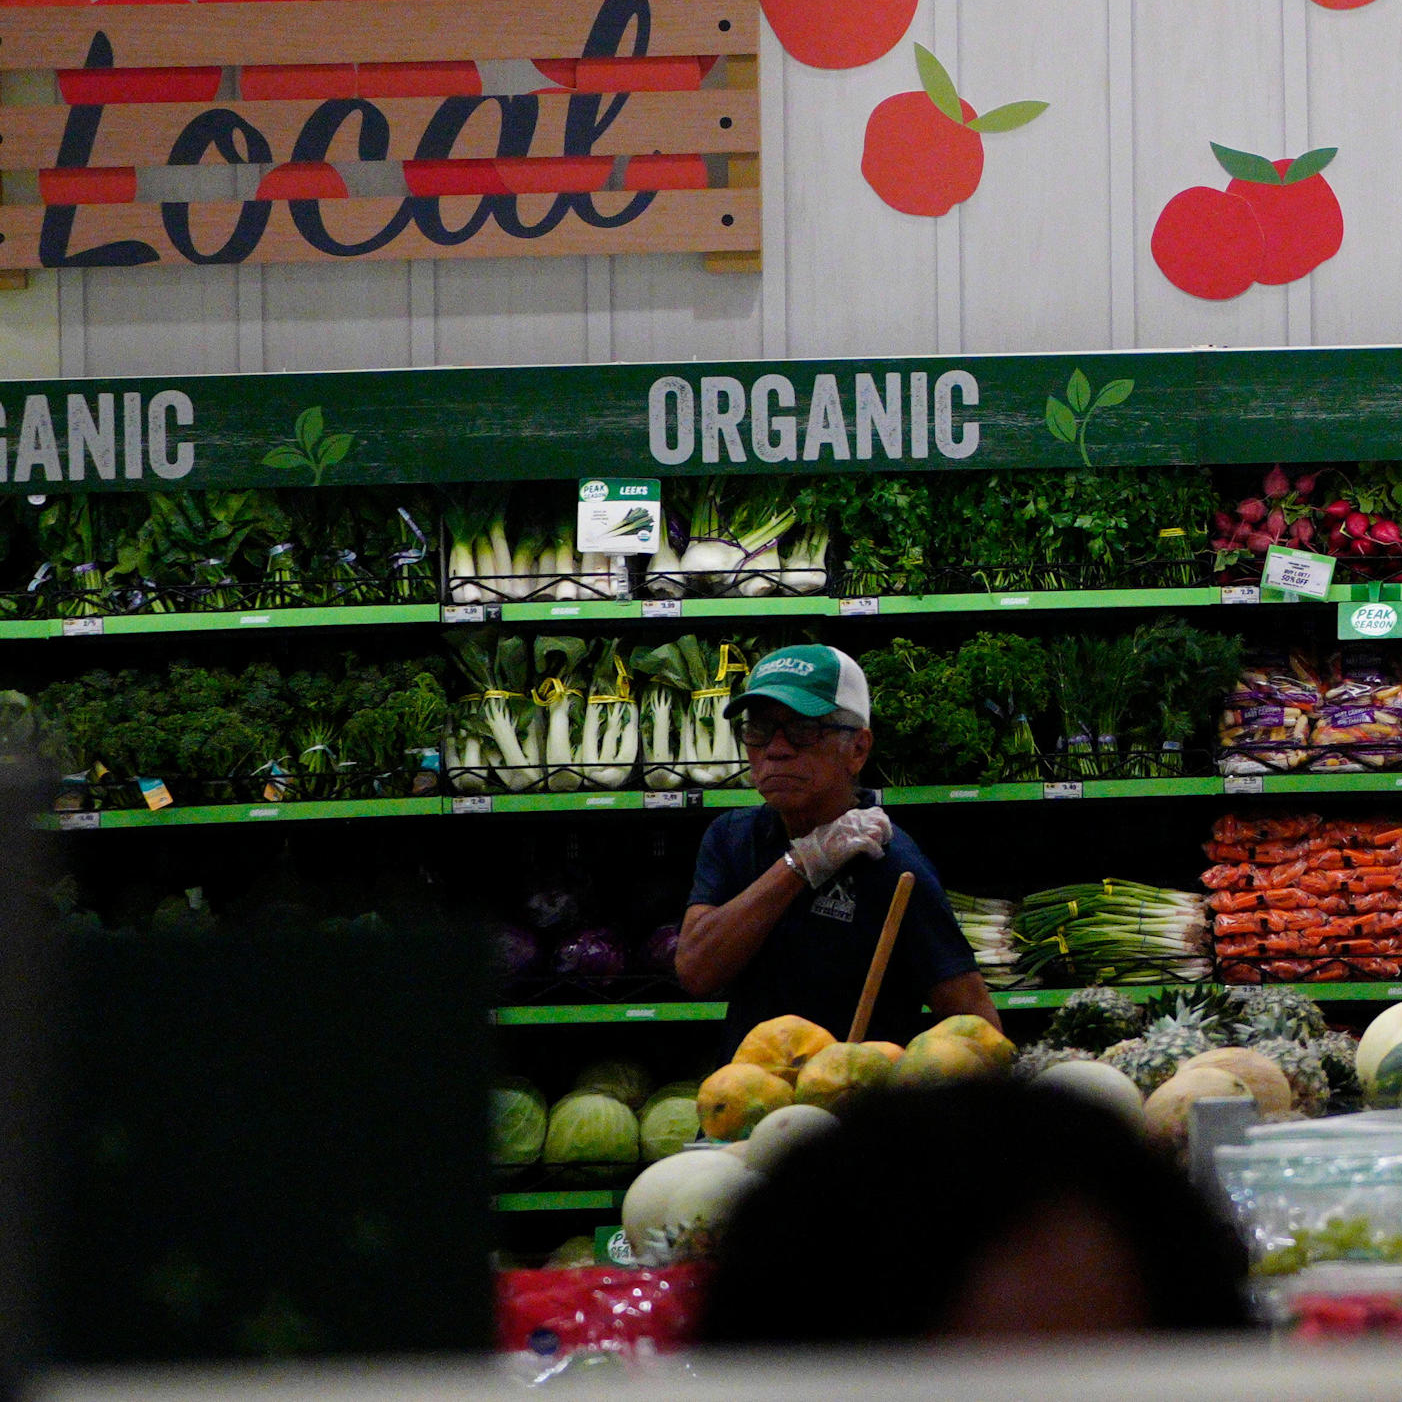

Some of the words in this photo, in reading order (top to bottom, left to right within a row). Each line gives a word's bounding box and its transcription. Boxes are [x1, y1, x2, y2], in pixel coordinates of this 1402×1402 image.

[648, 369, 980, 466] ORGANIC
[0, 388, 196, 485] ANIC
[583, 484, 605, 493] PEAK
[620, 486, 648, 495] LEEKS
[1296, 578, 1309, 586] OFF
[1356, 609, 1393, 620] PEAK
[1354, 621, 1394, 629] SEASON
